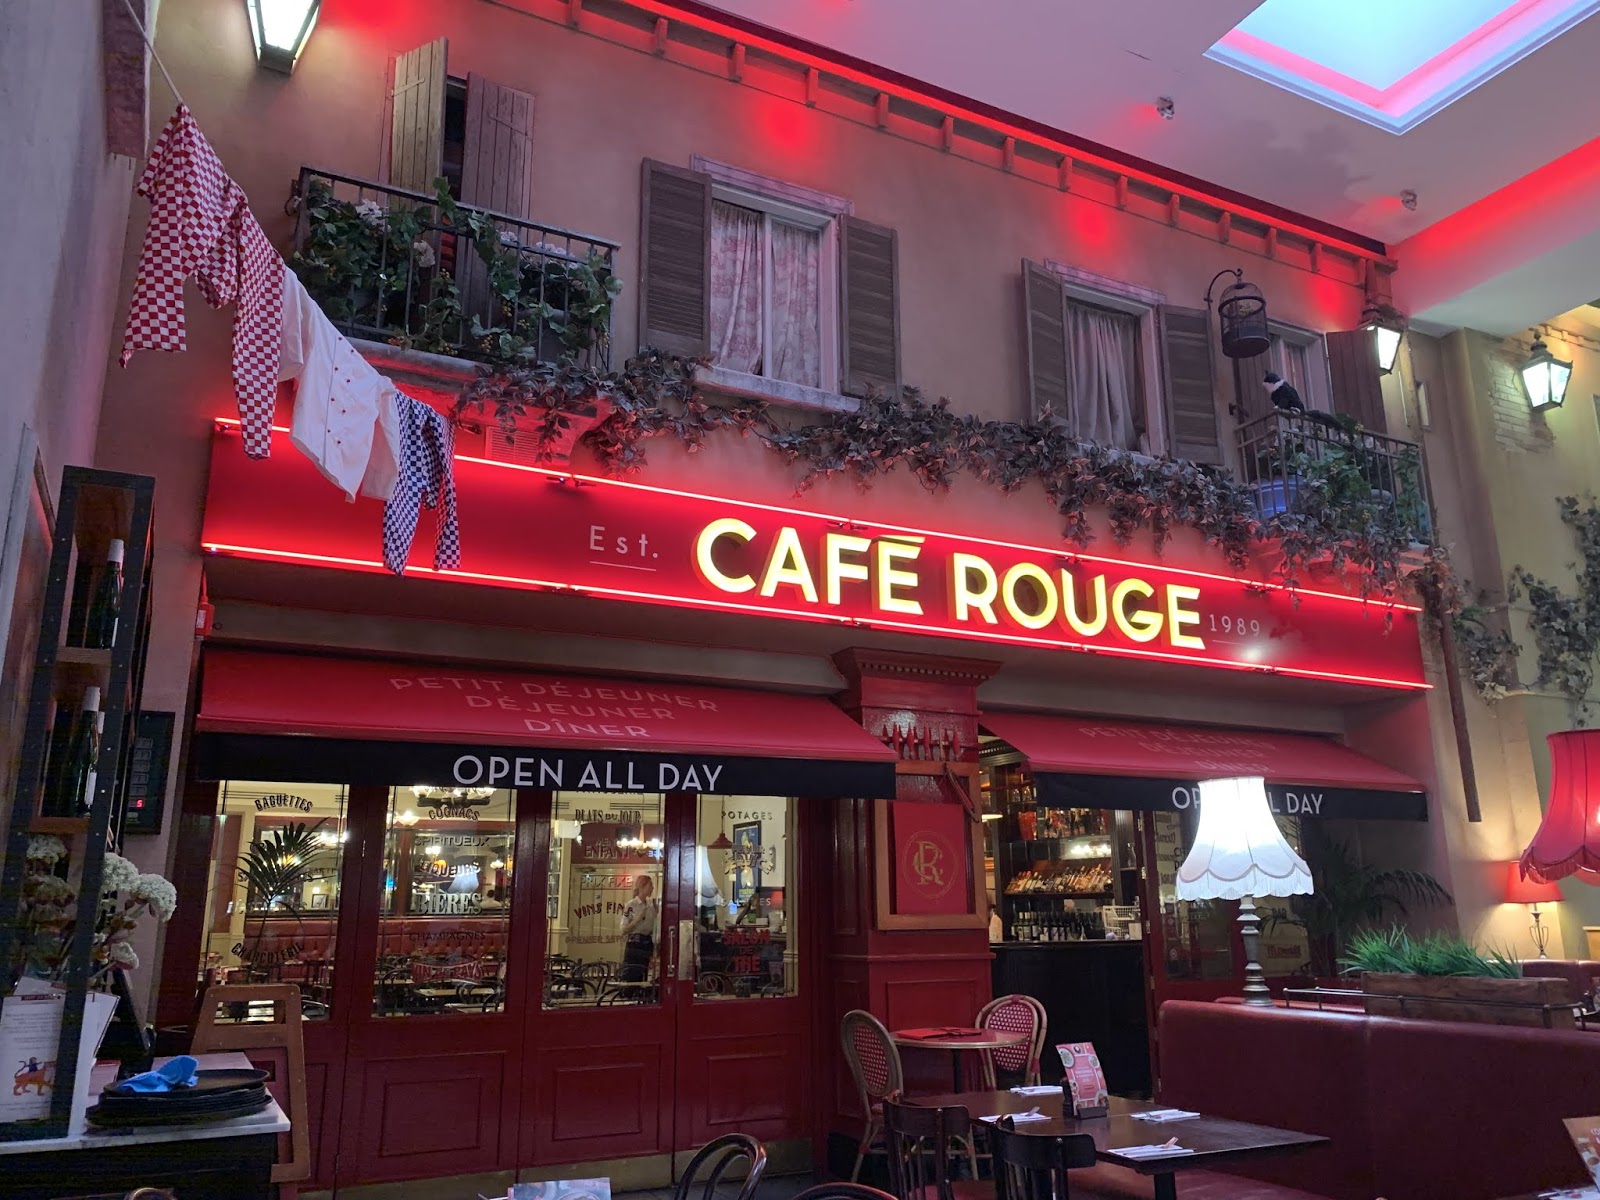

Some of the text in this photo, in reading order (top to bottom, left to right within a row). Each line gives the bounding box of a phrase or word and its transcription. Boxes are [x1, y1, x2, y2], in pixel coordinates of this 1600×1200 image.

[589, 517, 1261, 650] Est. CAFÉ ROUGE 1989
[389, 677, 719, 713] PETIT DÉJEUNER
[465, 695, 676, 720] DÉJEUNER
[523, 718, 651, 738] DÎNER
[453, 754, 723, 792] OPEN ALL DAY
[254, 794, 313, 813] BAGUETTES
[428, 806, 481, 821] COGNACS
[1285, 792, 1323, 815] DAY
[575, 808, 604, 823] PLATS
[618, 810, 641, 825] JOUR
[722, 810, 773, 821] POTAGES
[574, 902, 635, 919] VINS FINS
[409, 930, 487, 942] CHAMPAGNES
[231, 942, 305, 964] CHARCUTERIE
